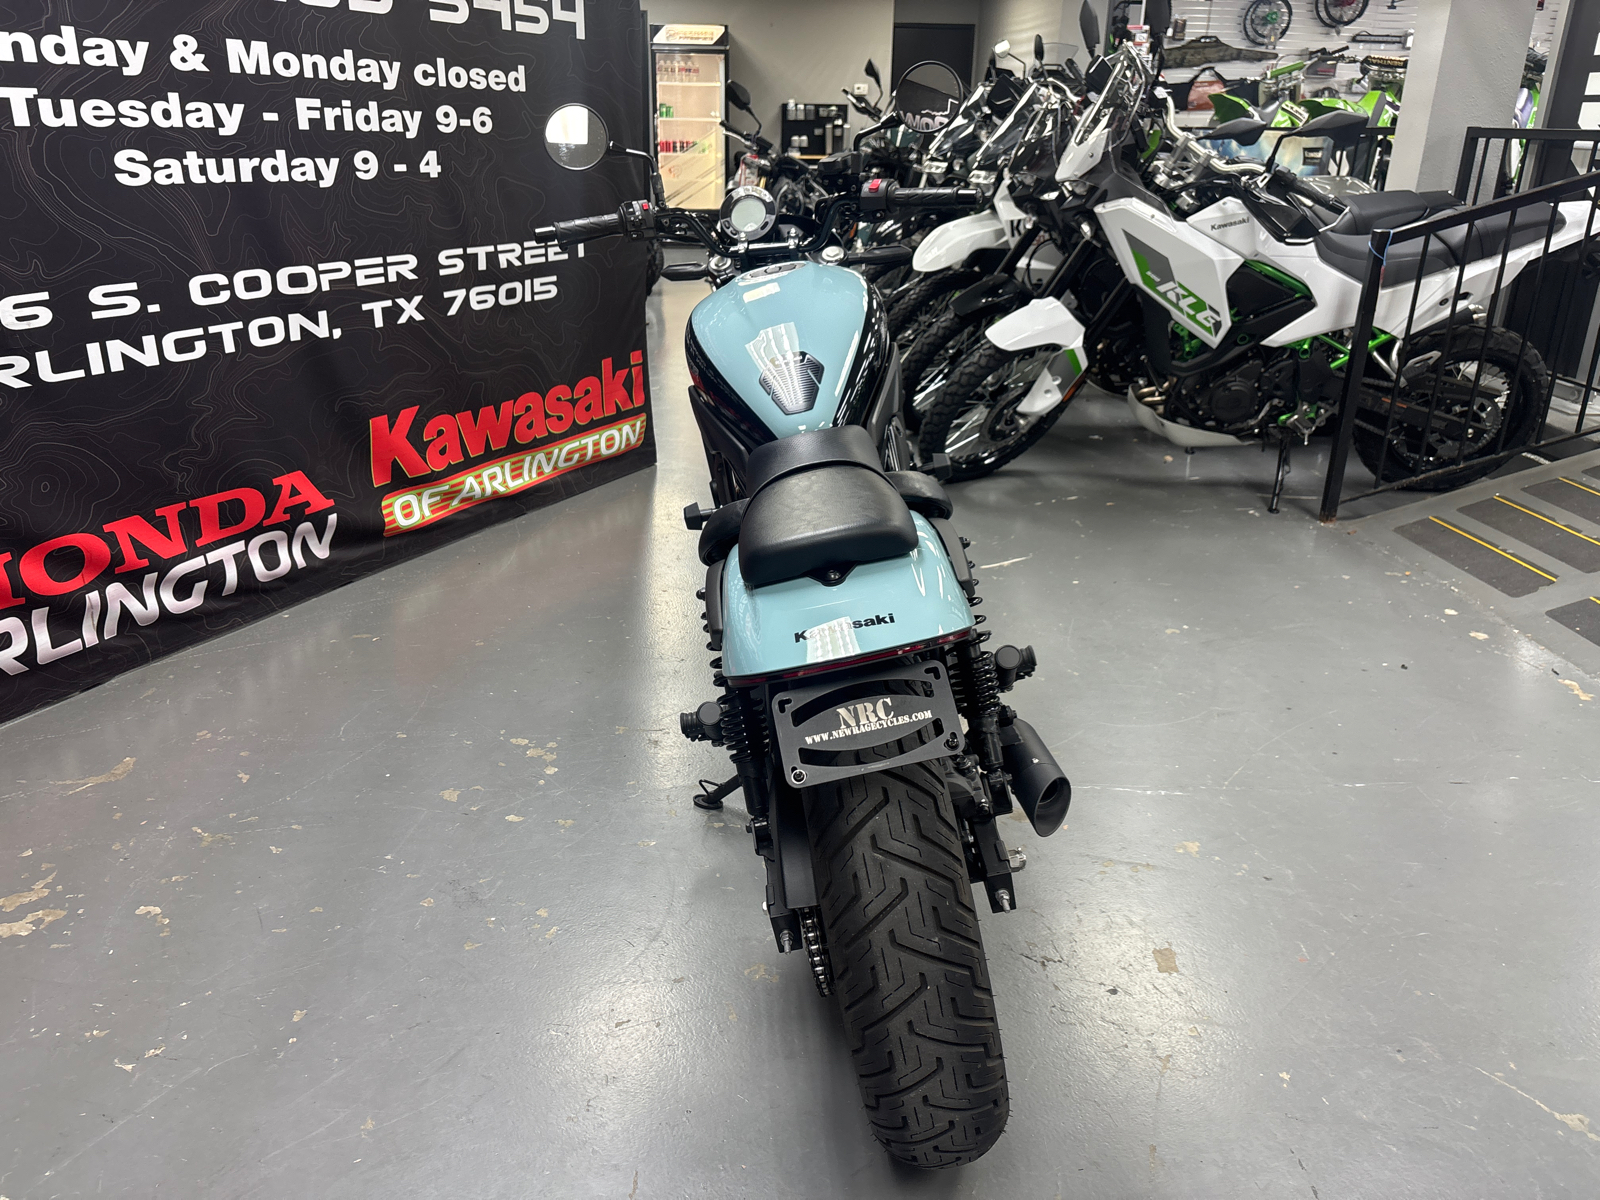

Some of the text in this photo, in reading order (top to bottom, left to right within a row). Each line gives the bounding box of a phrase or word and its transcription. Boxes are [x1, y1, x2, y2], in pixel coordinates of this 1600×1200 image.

[169, 33, 210, 72] &
[225, 38, 401, 90] Monday
[413, 57, 527, 92] closed
[0, 86, 245, 136] Tuesday
[295, 97, 422, 139] Friday
[435, 105, 493, 134] 9-6
[113, 149, 339, 188] Saturday
[353, 150, 379, 180] 9
[419, 150, 442, 178] 4
[1210, 216, 1250, 231] Kawasaki
[88, 281, 161, 320] S.
[188, 253, 419, 306] COOPER
[361, 295, 425, 329] TX
[443, 275, 558, 316] 76015
[370, 350, 645, 487] Kawasaki
[393, 421, 641, 527] OF ARLINGTON
[805, 710, 933, 745] WWW.NEWRAGECYCLES.COM
[836, 697, 895, 730] NRC
